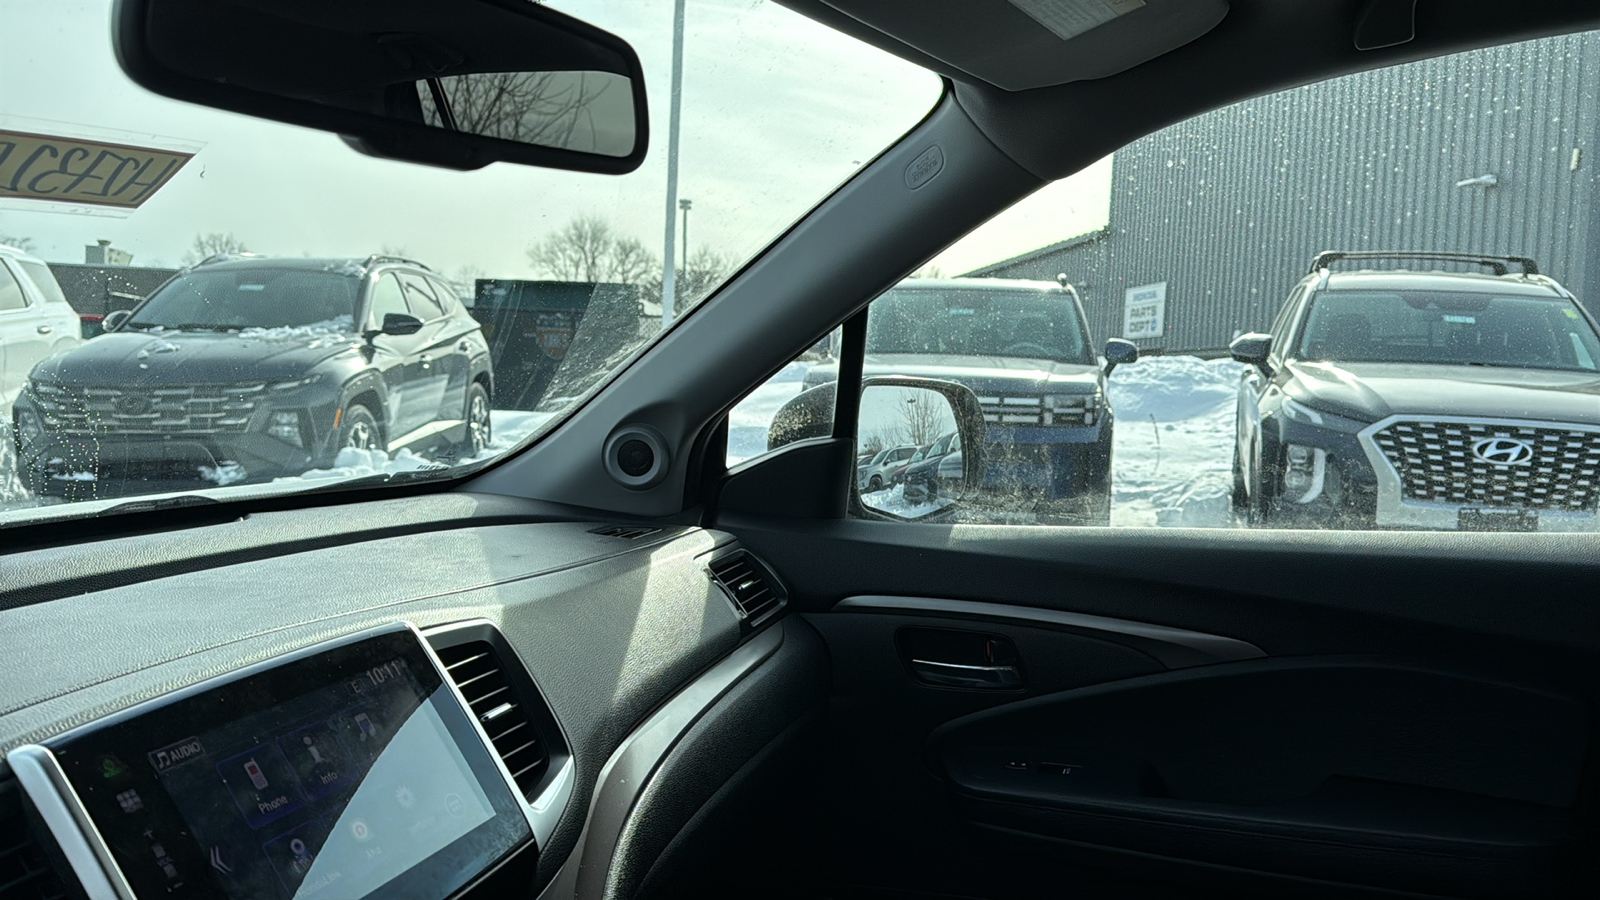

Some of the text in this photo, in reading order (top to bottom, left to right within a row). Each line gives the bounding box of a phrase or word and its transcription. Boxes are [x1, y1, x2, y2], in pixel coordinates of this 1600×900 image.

[1130, 305, 1158, 319] PARTS
[366, 660, 401, 685] 10:11
[170, 741, 201, 762] AUDIO
[320, 771, 338, 784] Info
[258, 795, 288, 815] Phone
